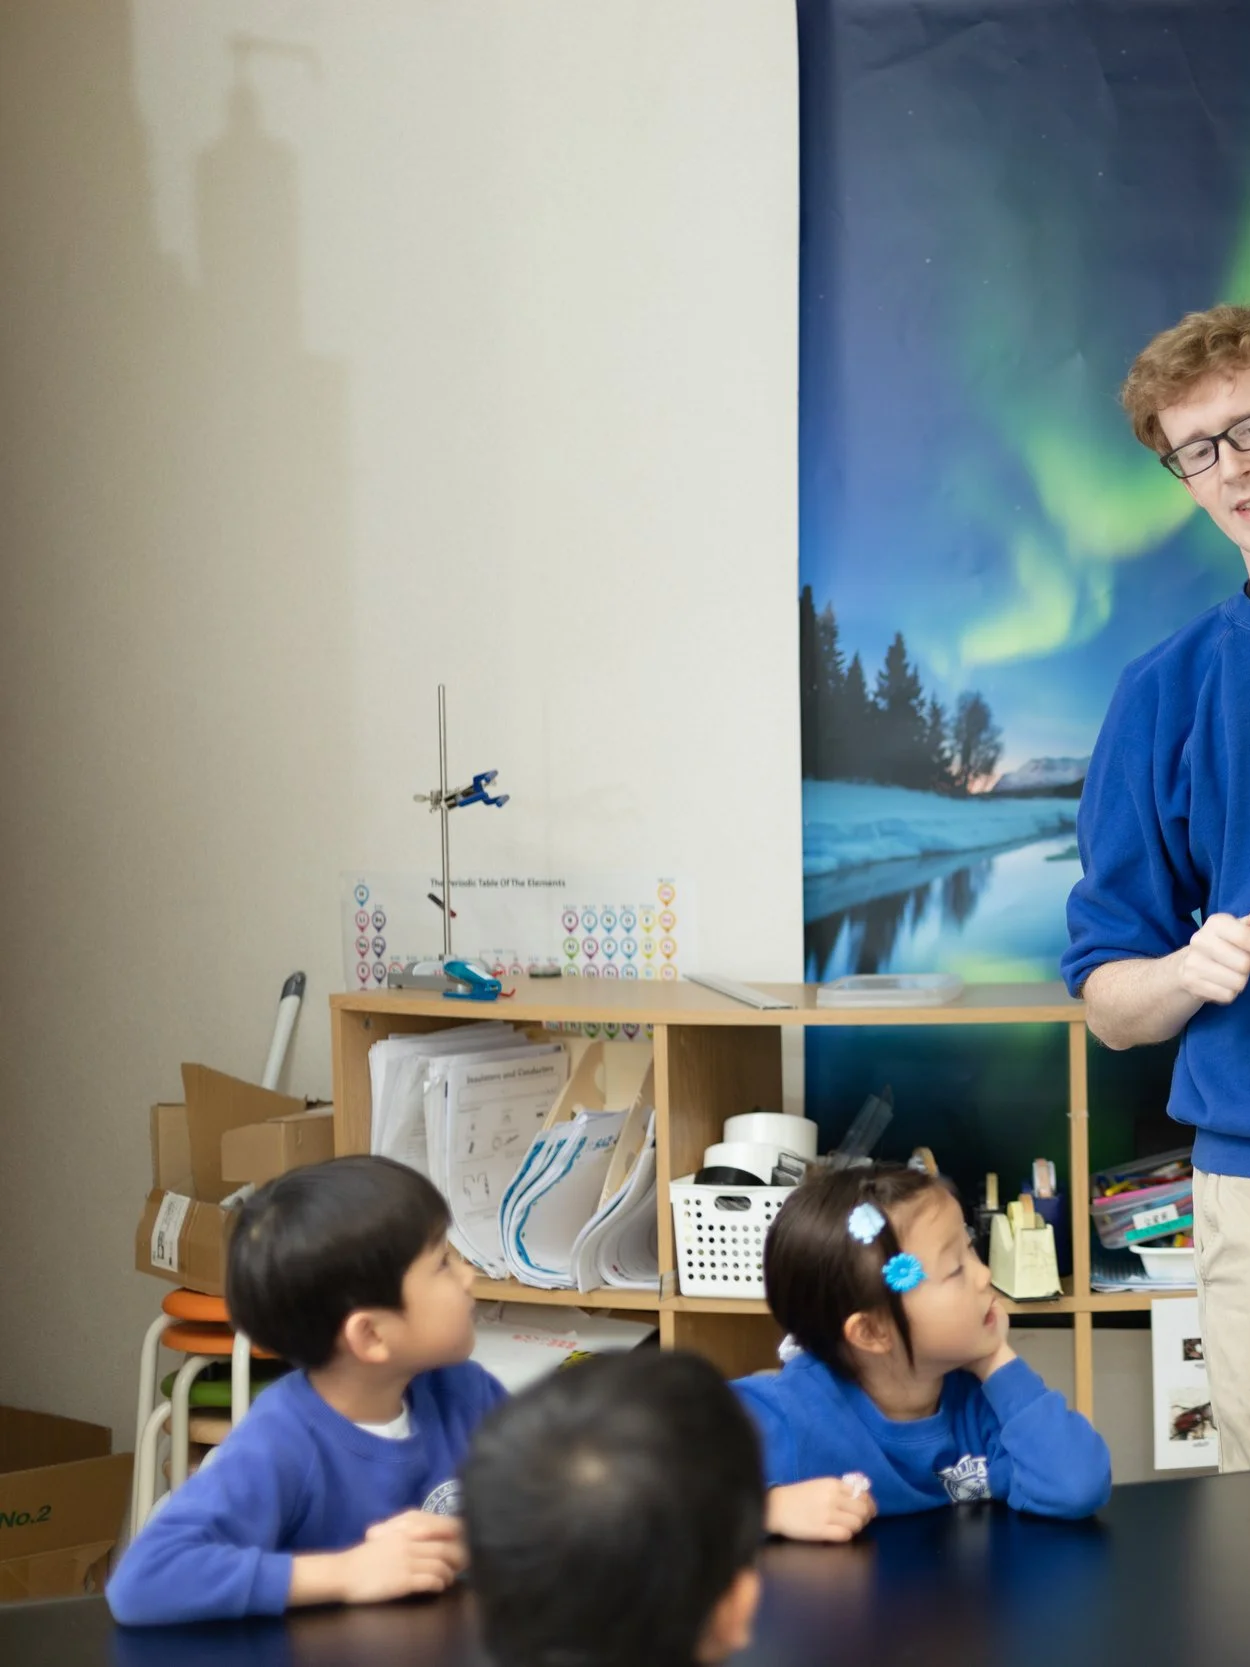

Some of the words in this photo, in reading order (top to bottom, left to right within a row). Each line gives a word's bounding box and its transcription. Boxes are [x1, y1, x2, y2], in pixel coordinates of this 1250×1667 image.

[430, 878, 443, 887] The
[447, 878, 476, 888] eriodic
[478, 878, 498, 888] Table
[500, 878, 510, 888] Of
[511, 878, 525, 888] The
[527, 878, 566, 888] Elements
[503, 1069, 516, 1079] and
[0, 1504, 52, 1530] No.2
